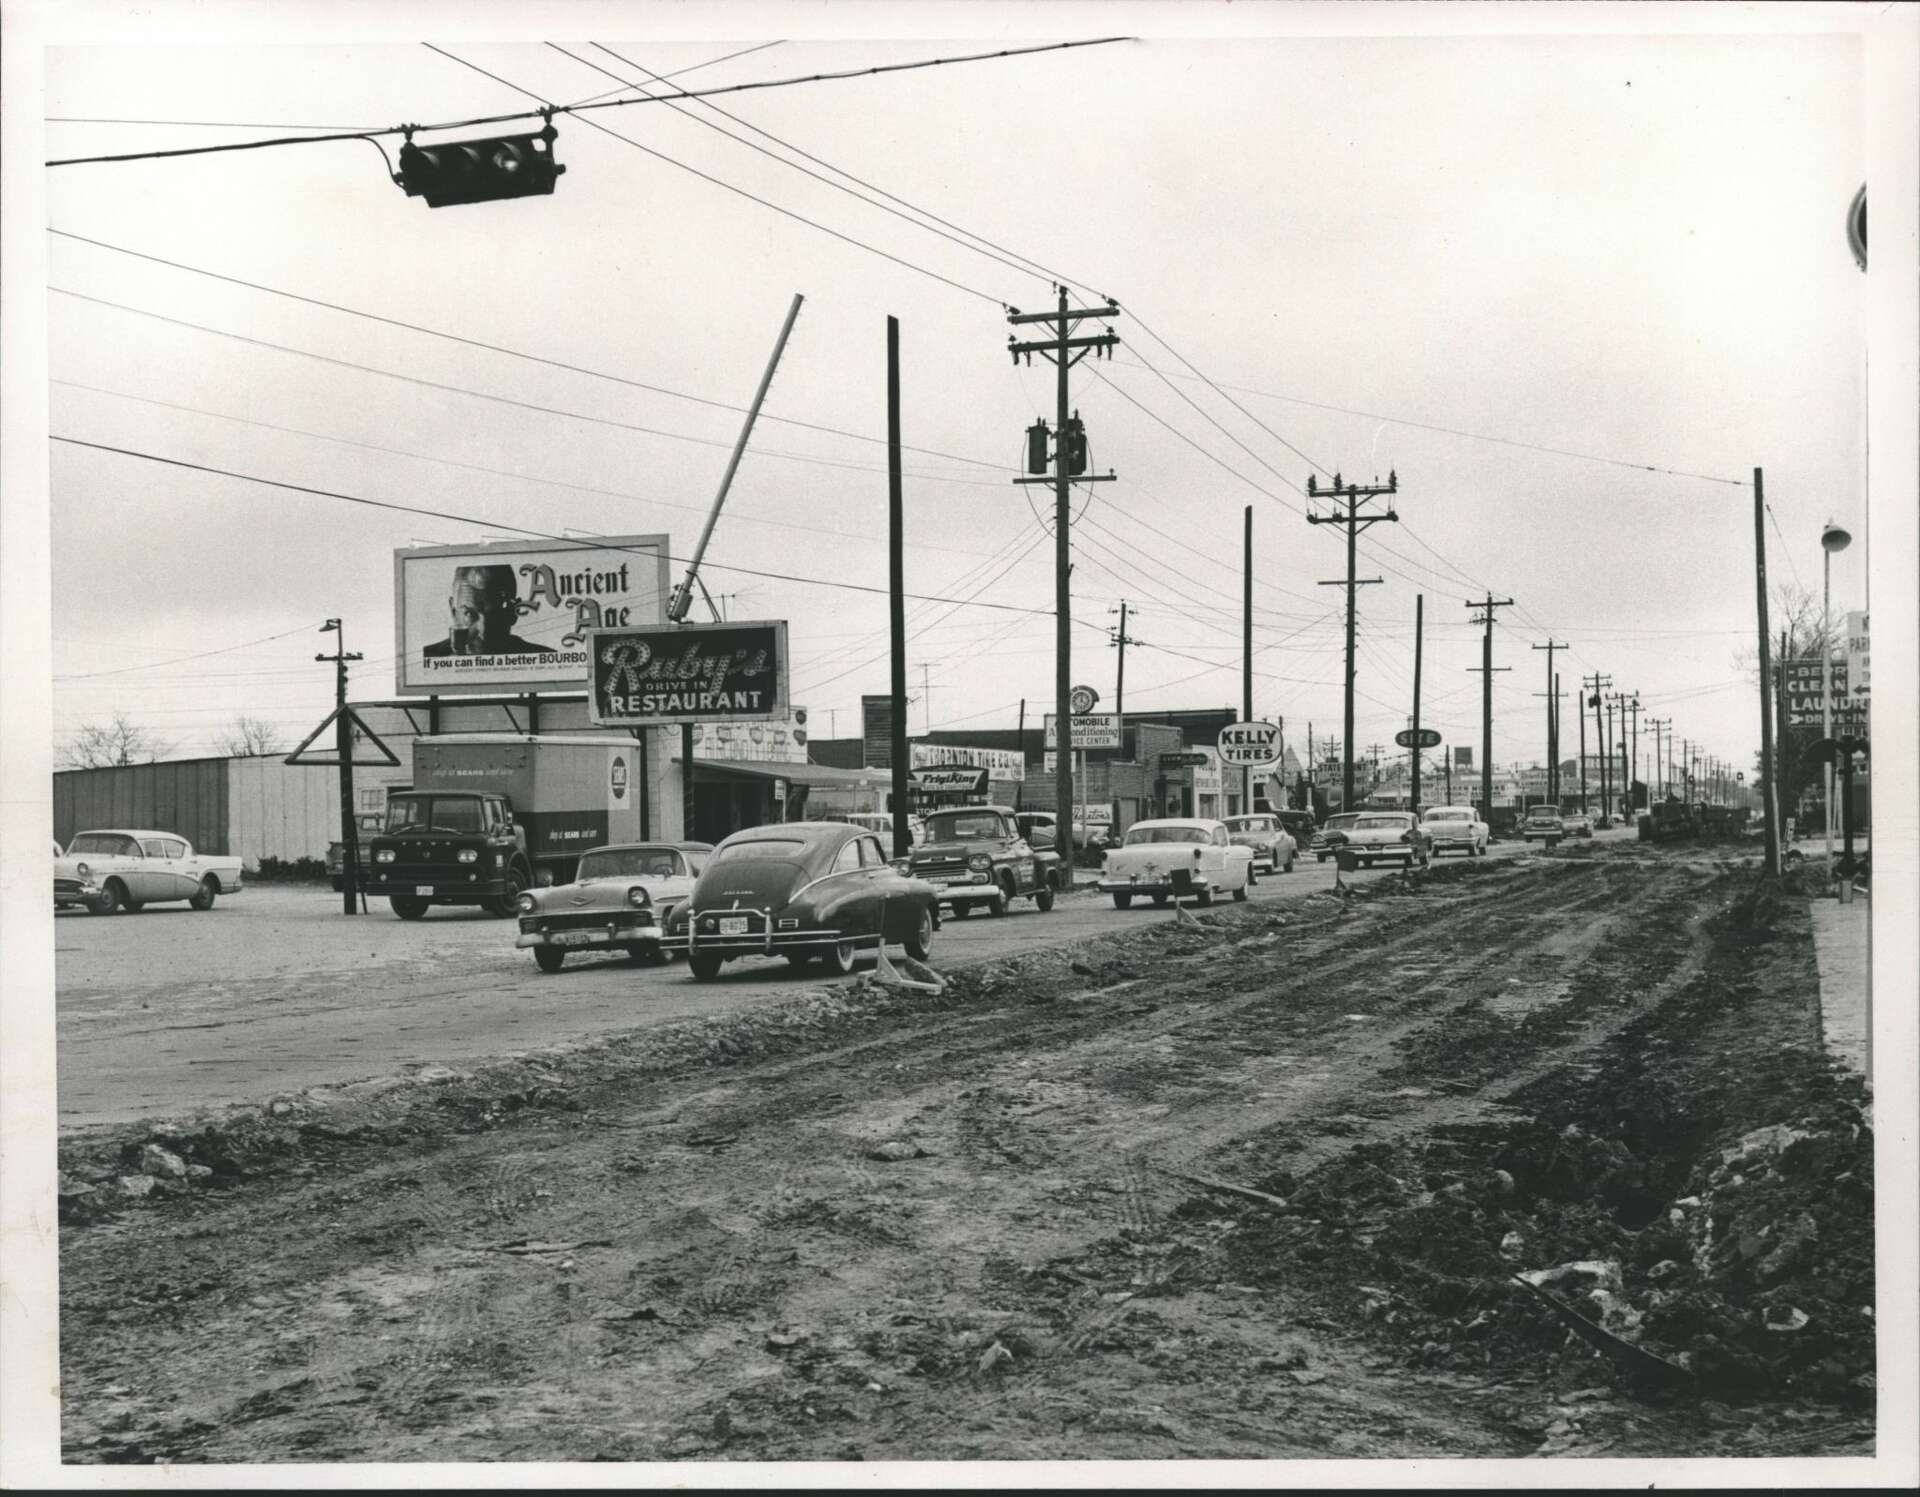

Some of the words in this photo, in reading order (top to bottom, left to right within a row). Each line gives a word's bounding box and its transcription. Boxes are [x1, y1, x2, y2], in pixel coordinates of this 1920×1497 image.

[515, 563, 629, 616] Ancient
[562, 597, 630, 647] Age
[1850, 637, 1870, 653] PAR
[423, 657, 431, 668] If
[433, 660, 453, 670] you
[455, 659, 473, 668] can
[475, 656, 494, 667] find
[496, 658, 503, 666] a
[505, 654, 537, 665] better
[539, 652, 588, 664] BOURBO
[601, 638, 771, 696] Ruby's
[646, 681, 687, 691] DRIVE
[694, 680, 708, 690] IN
[610, 691, 762, 713] RESTAURANT
[1056, 718, 1110, 727] OMOBILE
[1805, 713, 1869, 724] DRVE-IN
[1070, 727, 1118, 739] onditioning
[1222, 730, 1277, 744] KELLY
[1087, 737, 1110, 745] CENTER
[1226, 749, 1273, 760] TIRES
[922, 772, 977, 785] FrigiKing
